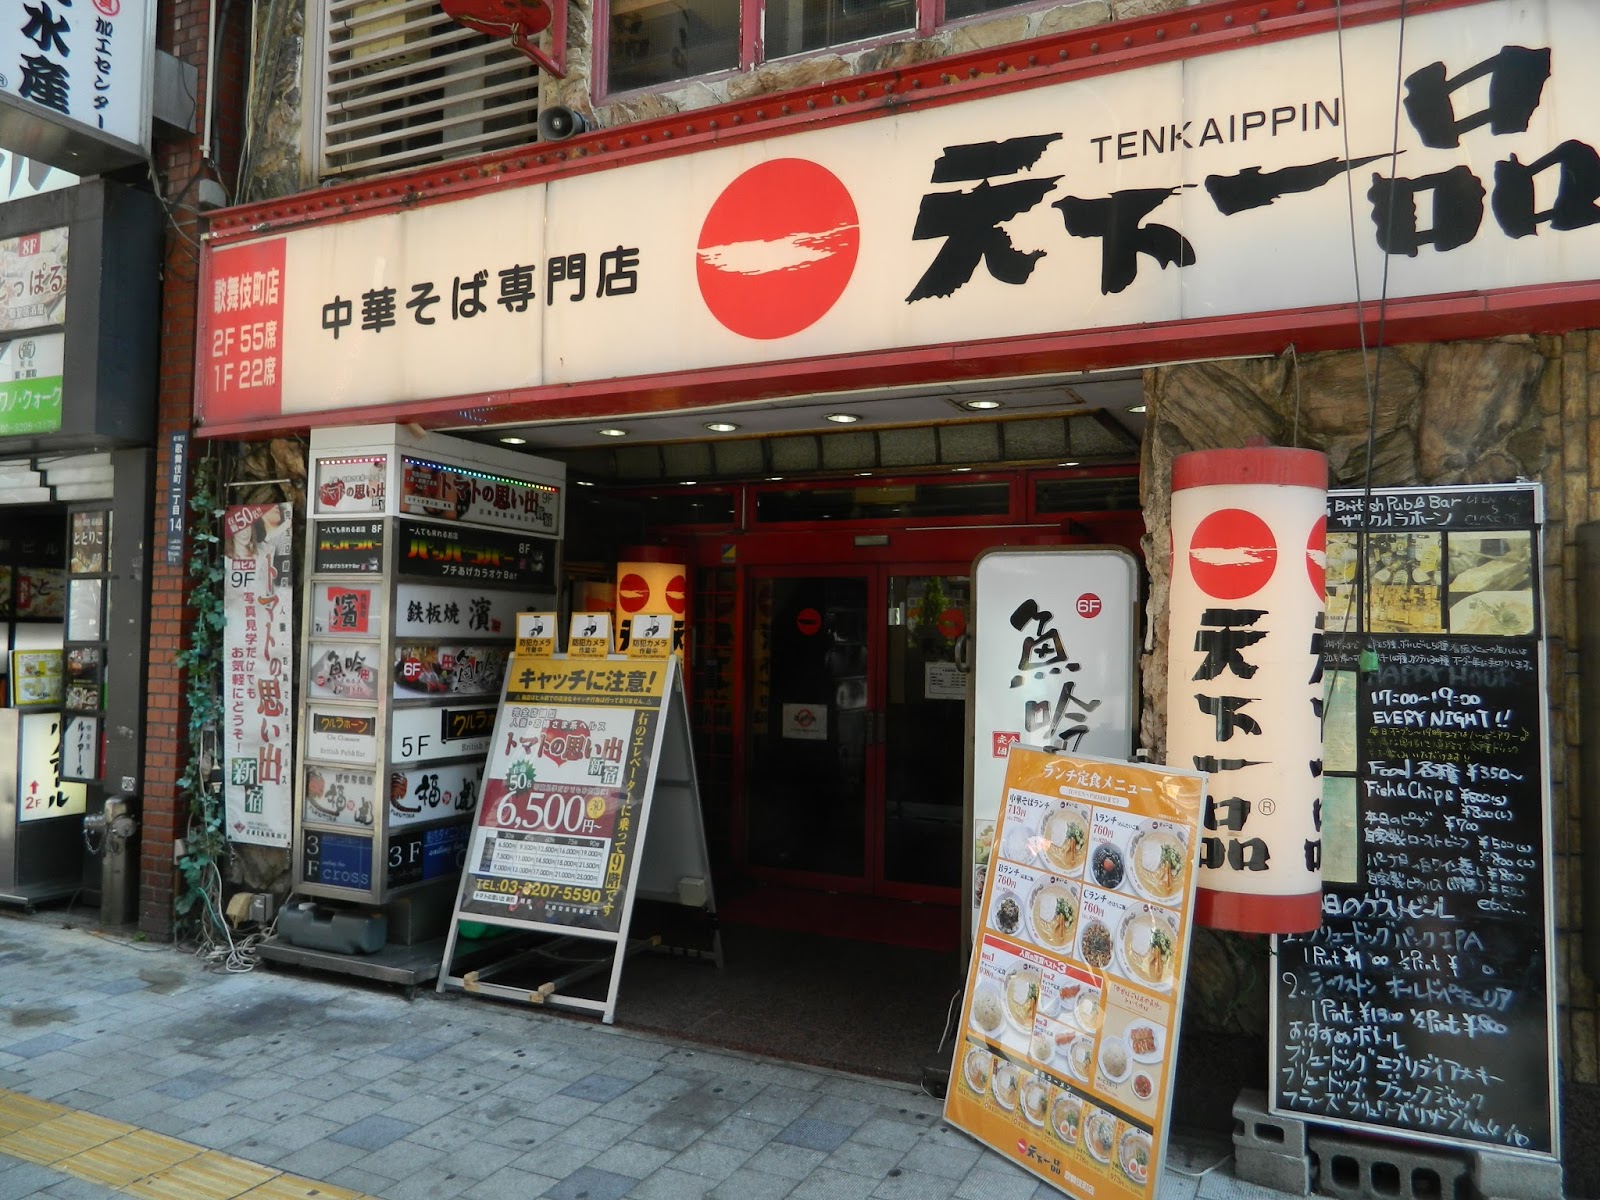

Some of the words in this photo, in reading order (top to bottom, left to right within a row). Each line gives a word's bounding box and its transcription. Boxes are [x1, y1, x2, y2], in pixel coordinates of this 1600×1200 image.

[18, 0, 73, 115] 水産
[94, 15, 114, 129] 加工センター
[1091, 97, 1340, 165] TENKAIPPIN
[907, 45, 1600, 305] 天下一品
[22, 238, 38, 256] 8F
[213, 267, 280, 314] 歌舞伎町店
[321, 245, 640, 340] 中華そば専門店
[213, 328, 235, 357] 2F
[240, 320, 277, 352] 55席
[213, 363, 234, 392] 1F
[238, 358, 277, 388] 22席
[169, 517, 183, 532] 14
[371, 524, 383, 534] 8F
[407, 599, 460, 625] 鉄板焼
[1077, 601, 1100, 613] 6F
[403, 662, 422, 677] 6F
[519, 668, 657, 694] キャッチに注意!
[1372, 709, 1426, 728] EVERY
[1430, 709, 1489, 729] NIGHT
[504, 731, 624, 764] トマトの思い出
[1043, 764, 1153, 795] ランチ定食メニュー
[1367, 758, 1411, 779] Food
[1093, 824, 1114, 839] 760円
[322, 868, 370, 886] cross
[1083, 901, 1105, 917] 760円
[1321, 887, 1455, 920] 日のゲストビール
